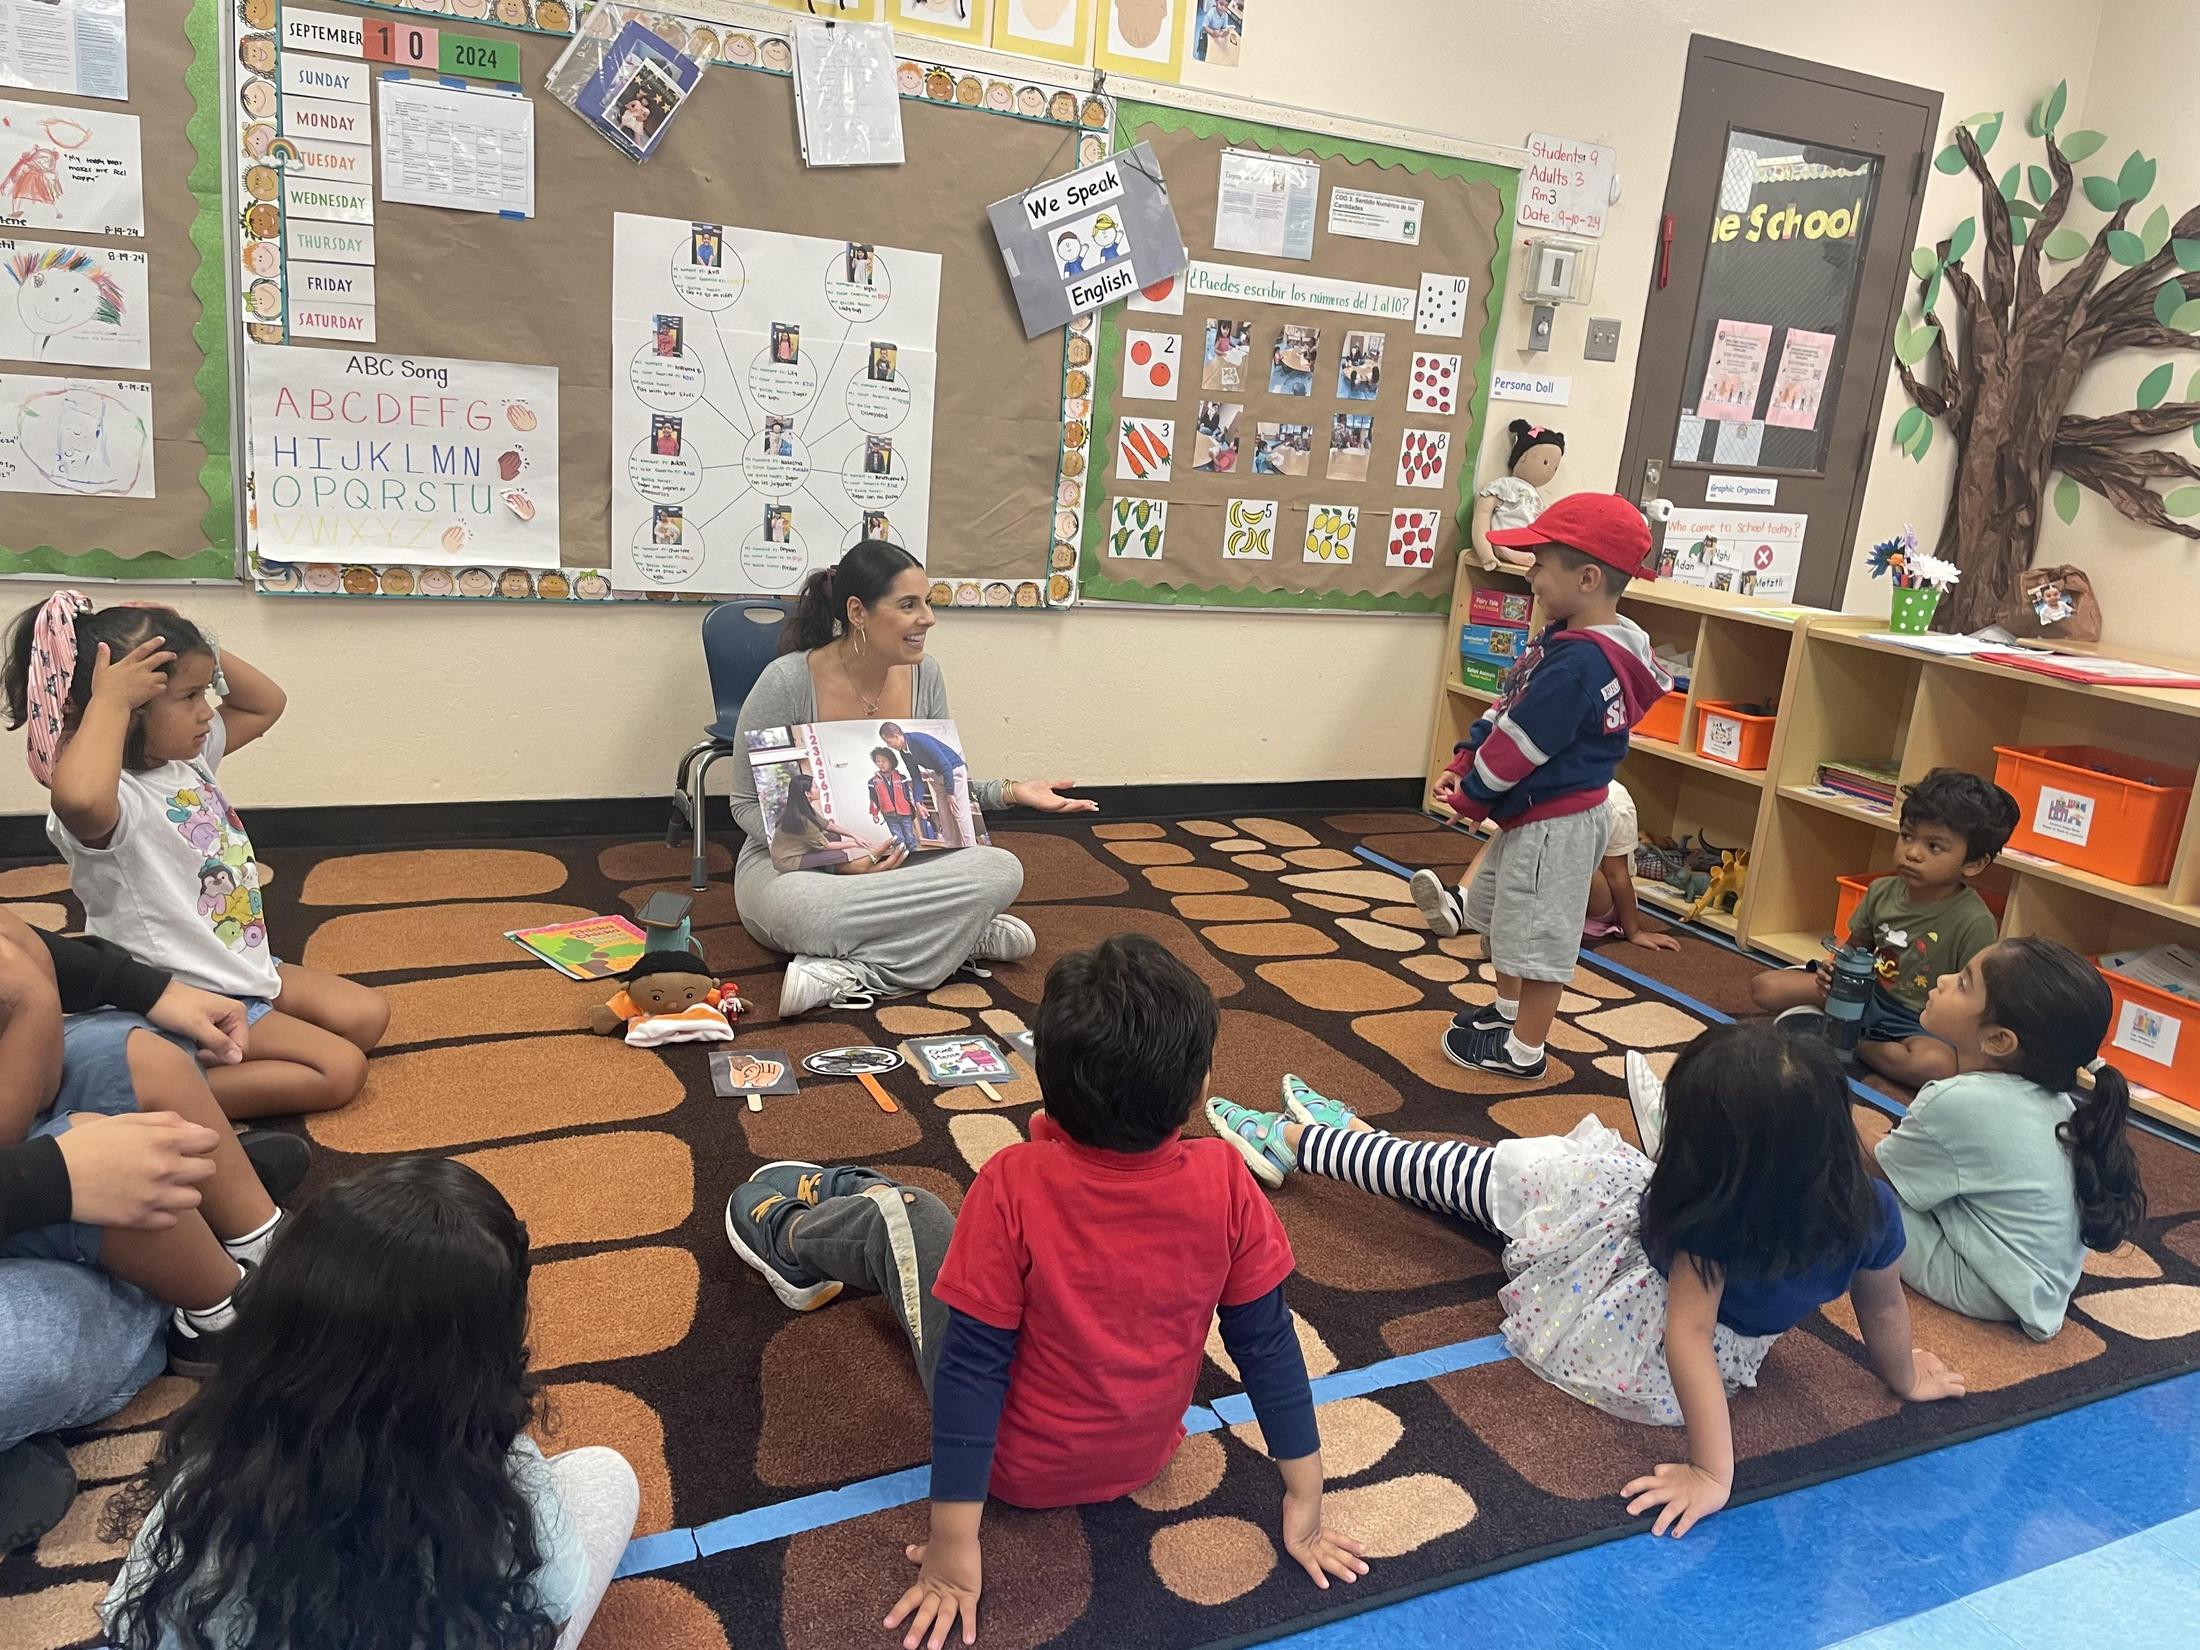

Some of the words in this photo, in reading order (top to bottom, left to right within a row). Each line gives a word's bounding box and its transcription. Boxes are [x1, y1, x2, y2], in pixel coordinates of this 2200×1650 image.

[289, 22, 363, 46] SEPTEMBER
[377, 27, 388, 56] 1
[409, 31, 423, 60] 0
[456, 45, 497, 69] 2024
[298, 70, 350, 89] SUNDAY
[296, 111, 355, 131] MONDAY
[300, 151, 356, 171] TUESDAY
[1590, 150, 1599, 166] 9
[1575, 171, 1585, 187] 3
[290, 190, 366, 210] WEDNESDAY
[1027, 197, 1060, 220] We
[1066, 171, 1119, 206] Speak
[1745, 198, 1862, 243] School
[297, 234, 363, 252] THURSDAY
[108, 251, 145, 264] 8-19-24
[307, 276, 353, 293] FRIDAY
[1071, 270, 1132, 306] English
[1190, 268, 1240, 294] ¿Puedes
[1244, 279, 1288, 300] escribir
[1291, 283, 1306, 303] los
[1309, 290, 1350, 309] números
[1353, 291, 1368, 310] del
[1453, 279, 1466, 294] 10
[299, 312, 364, 331] SATURDAY
[1164, 336, 1175, 354] 2
[346, 355, 394, 376] ABC
[401, 360, 448, 389] Song
[1449, 357, 1458, 373] 9
[1494, 376, 1532, 391] Persona
[1535, 381, 1554, 393] Doll
[1161, 423, 1170, 438] 3
[1436, 434, 1446, 449] 8
[1710, 484, 1735, 494] Graphic
[1736, 486, 1771, 495] Organizers
[1153, 502, 1163, 519] 4
[1264, 503, 1273, 518] 5
[1347, 508, 1356, 521] 6
[1429, 511, 1438, 527] 7
[1668, 519, 1687, 533] Who
[1720, 522, 1731, 532] to
[1675, 560, 1695, 571] Adan
[1476, 598, 1488, 606] Fairy
